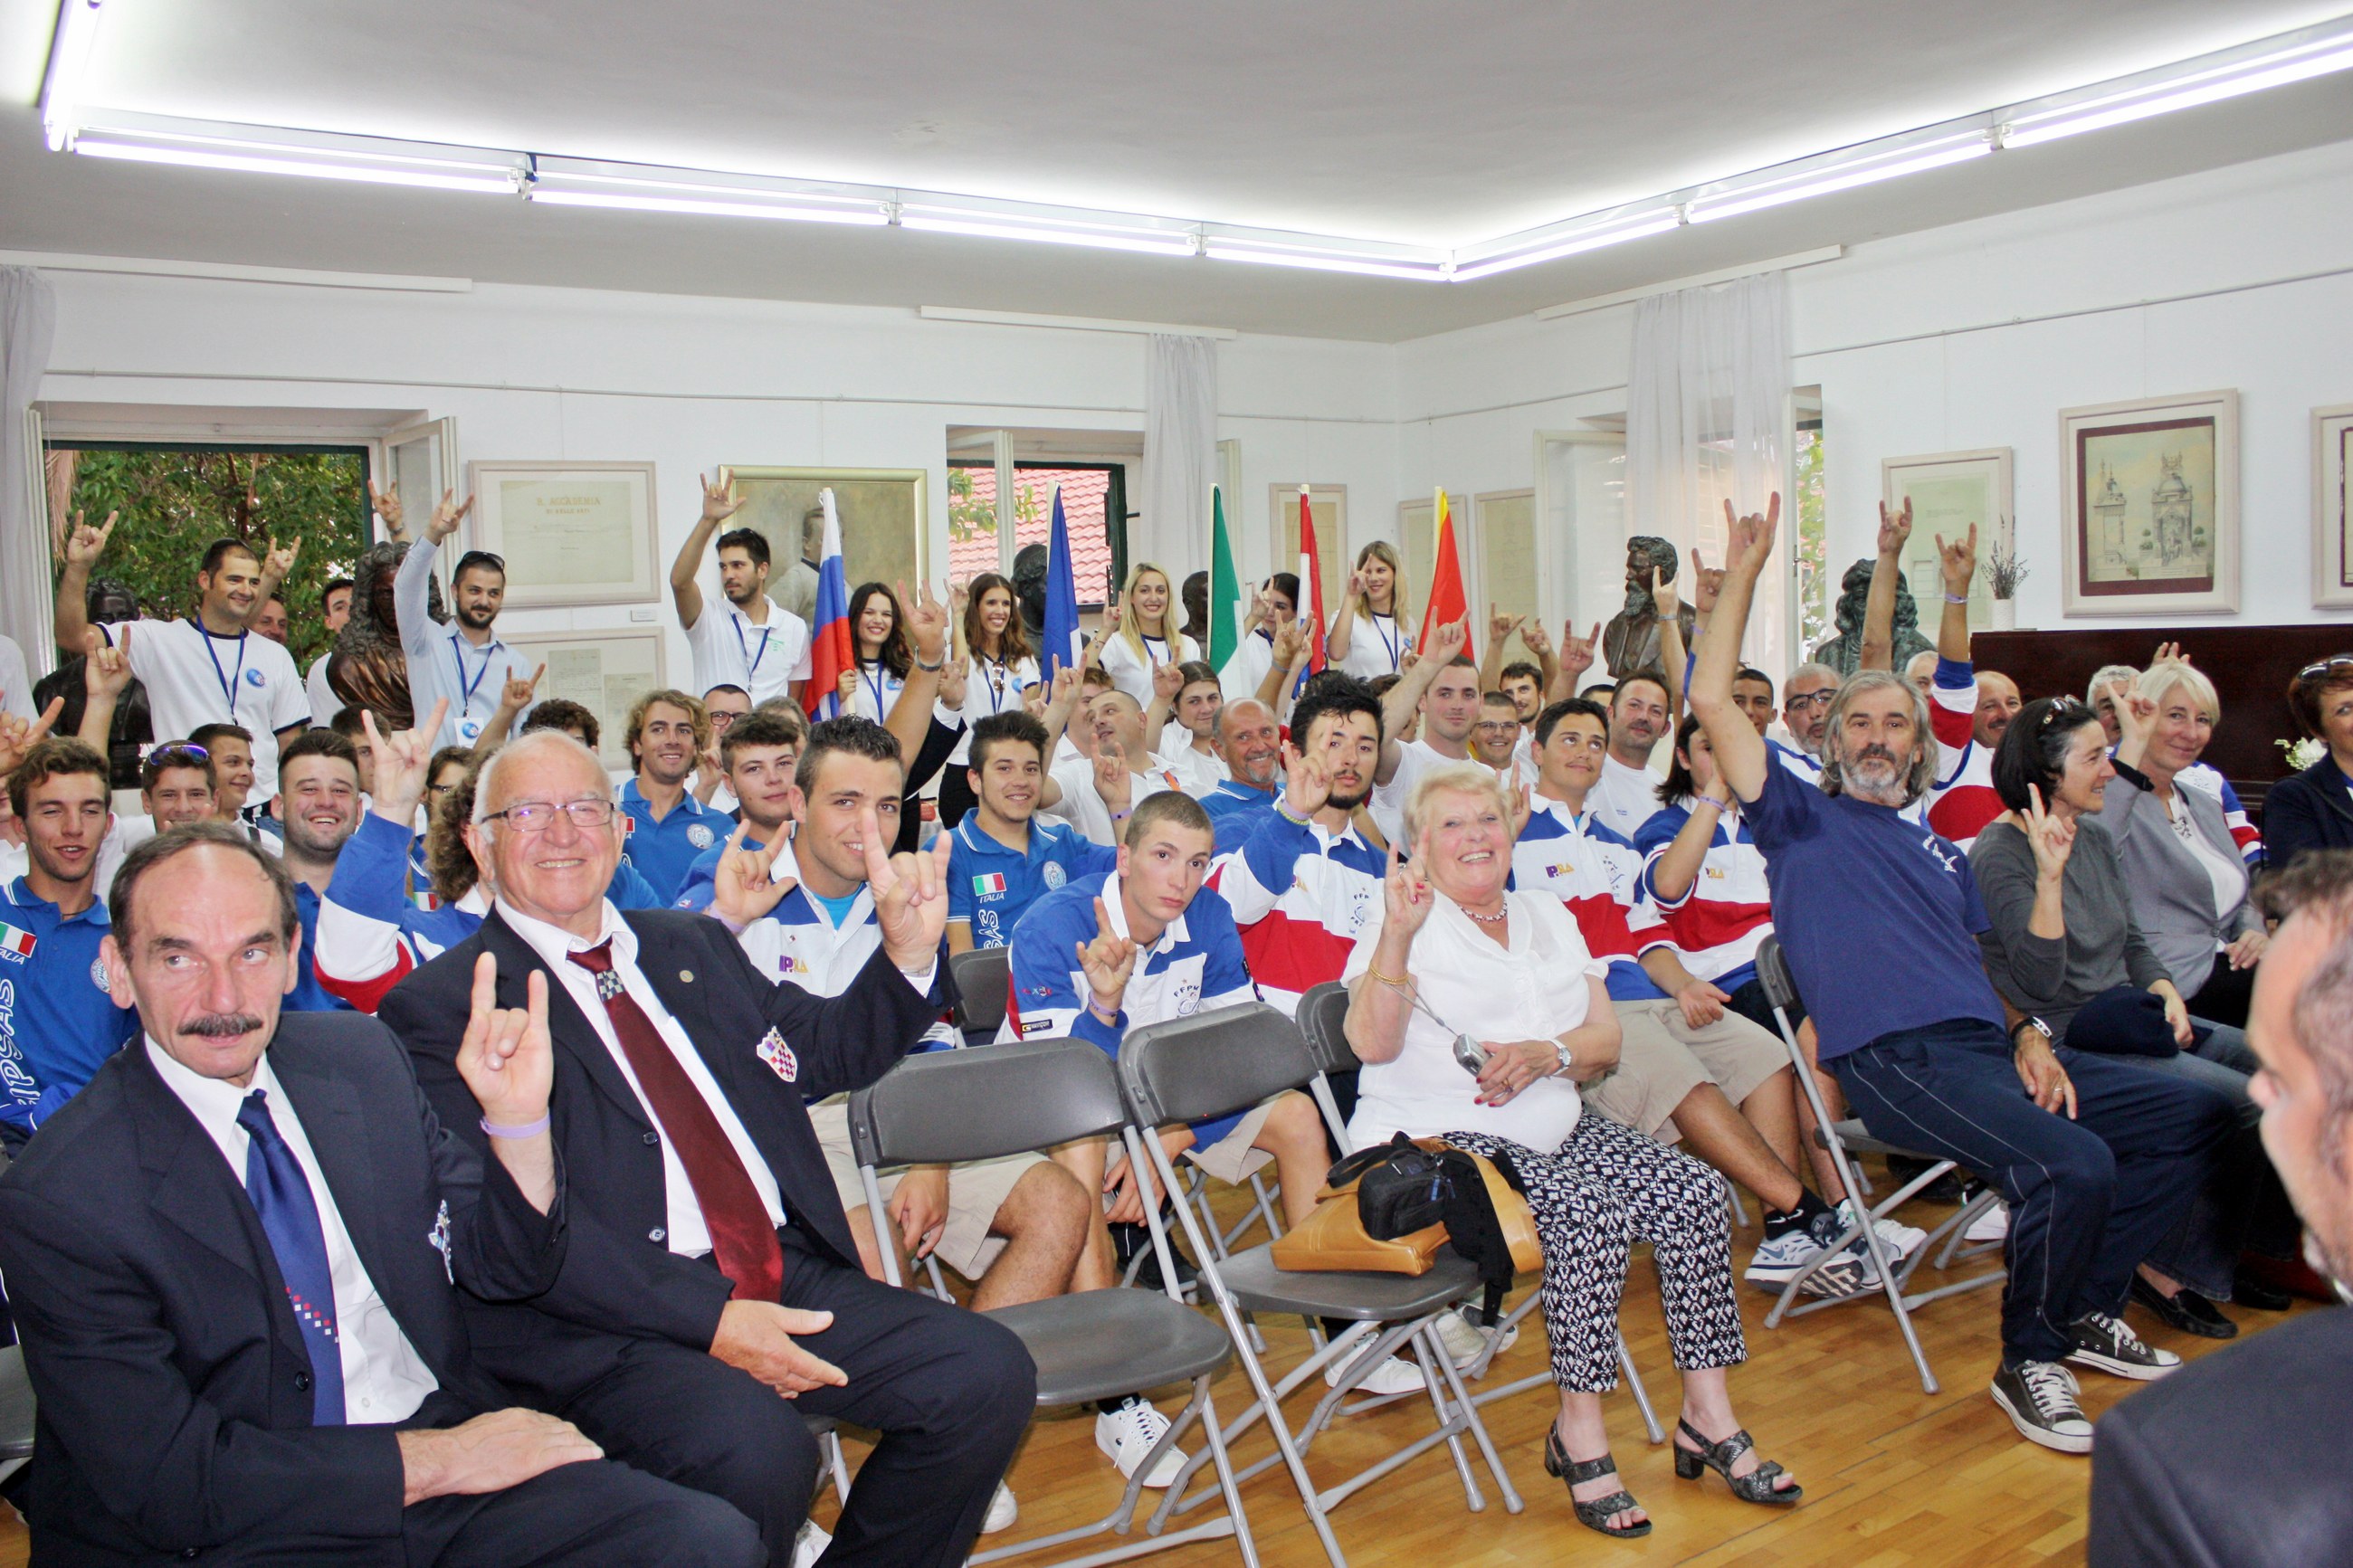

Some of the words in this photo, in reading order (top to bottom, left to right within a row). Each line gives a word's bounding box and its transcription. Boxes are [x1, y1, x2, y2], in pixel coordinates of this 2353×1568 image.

[549, 497, 601, 506] ACCADEMIA
[980, 893, 1005, 904] ITALIA
[0, 947, 25, 965] ALIA
